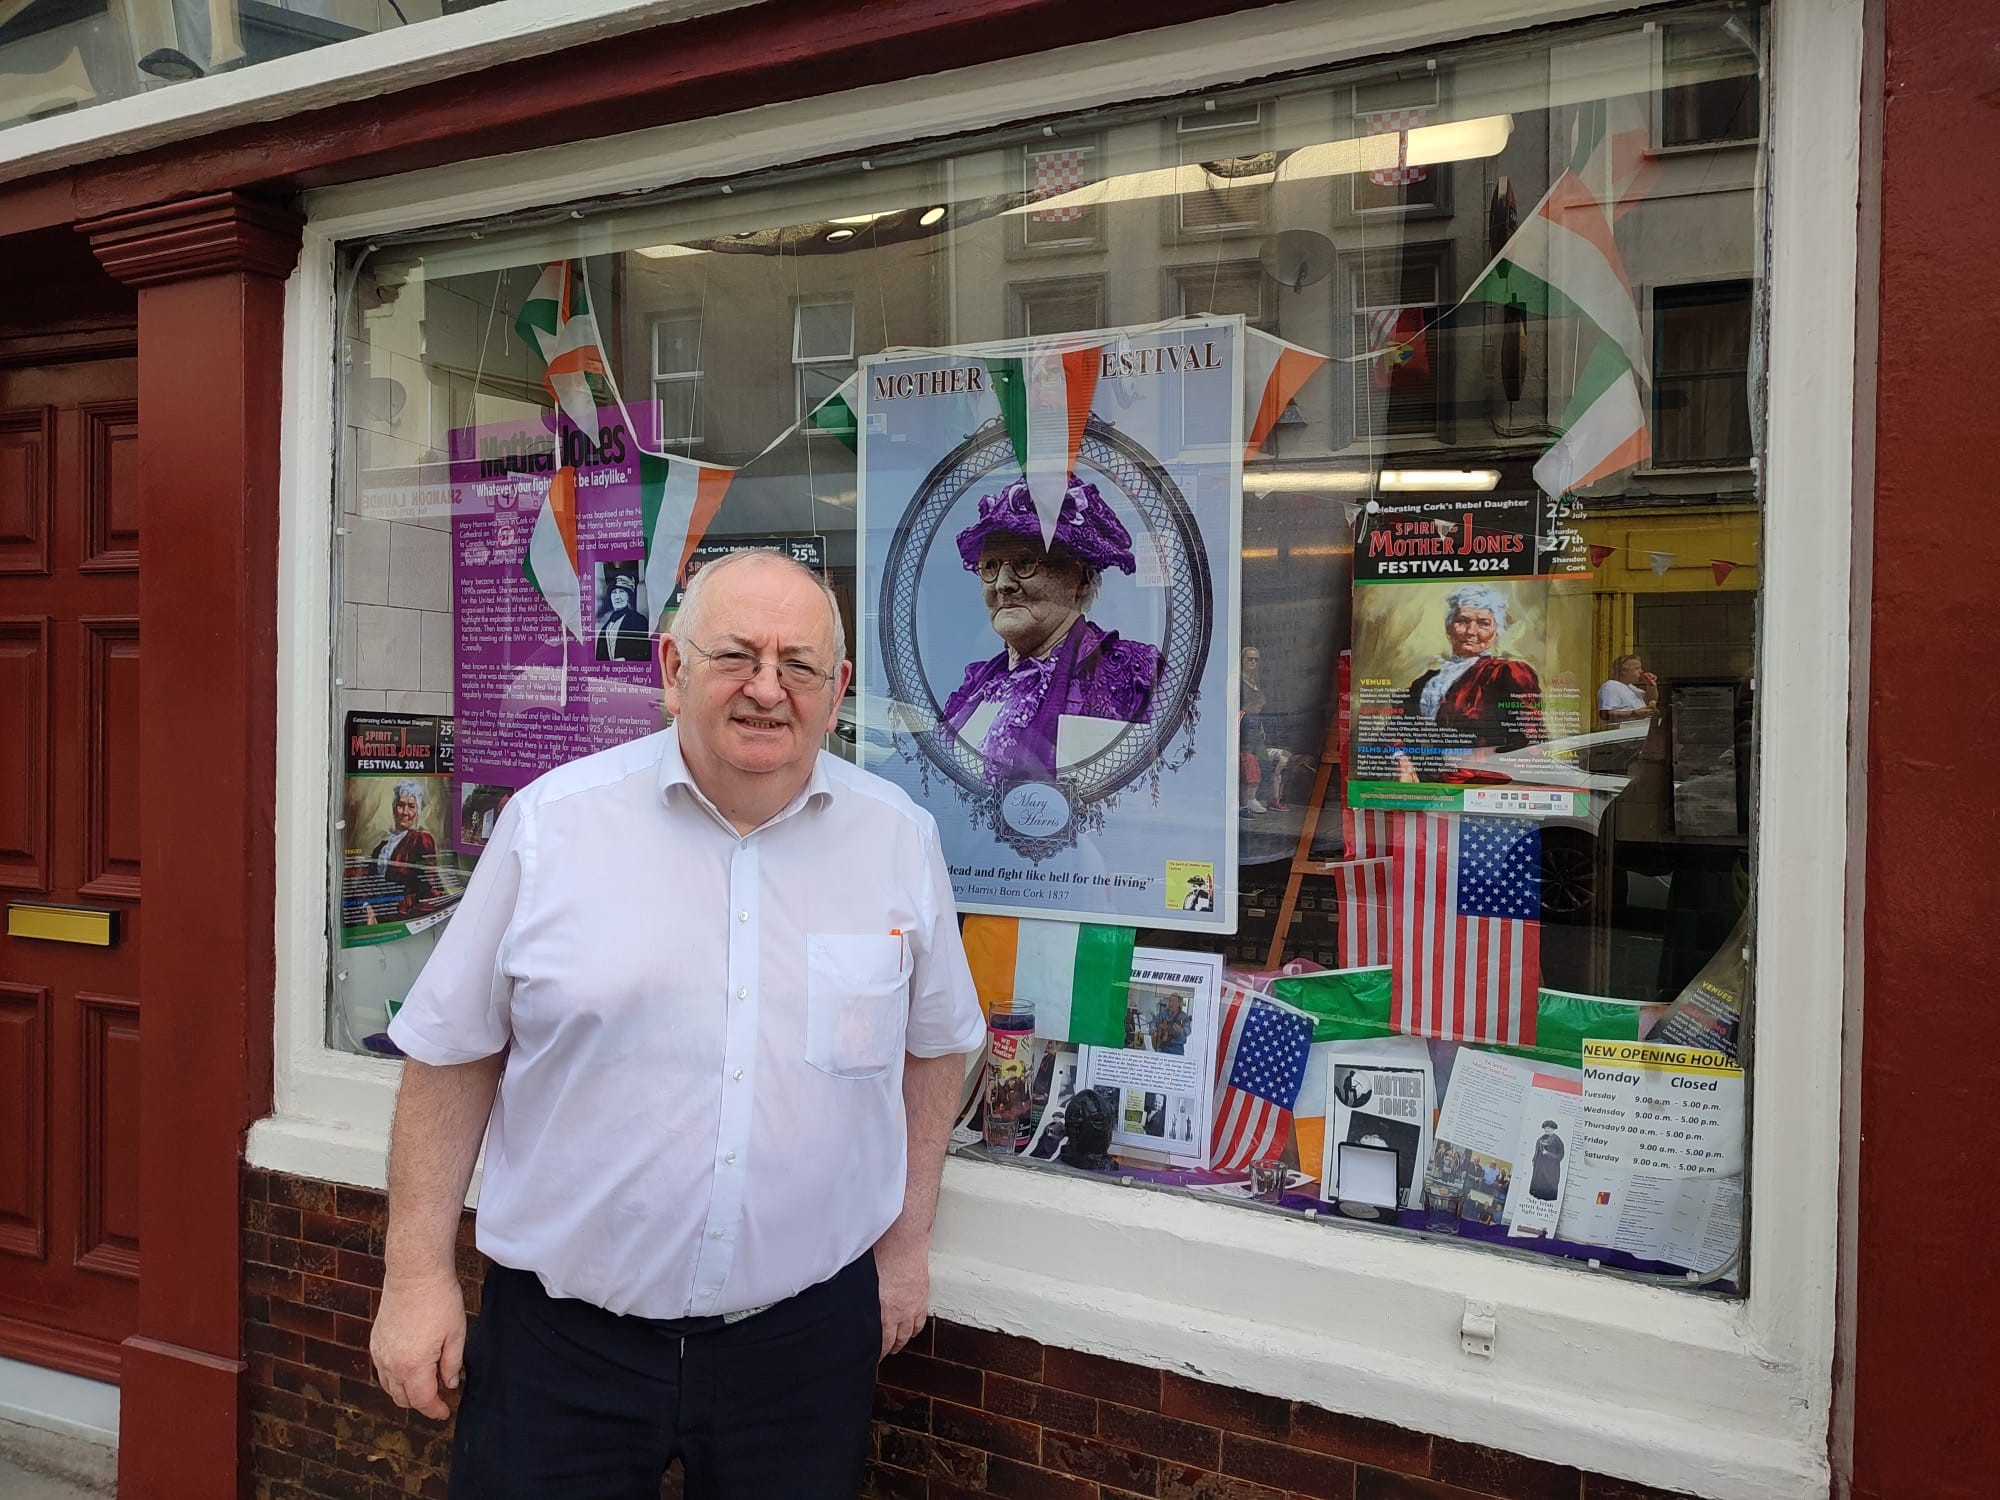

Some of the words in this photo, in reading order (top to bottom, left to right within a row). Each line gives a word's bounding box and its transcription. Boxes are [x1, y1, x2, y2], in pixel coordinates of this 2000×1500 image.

[874, 366, 984, 401] MOTHER
[1101, 342, 1223, 379] ESTIVAL
[560, 425, 626, 469] Jones
[471, 482, 513, 497] "Whatever
[514, 481, 531, 496] your
[579, 473, 589, 487] be
[591, 467, 632, 488] ladylike."
[1378, 504, 1421, 515] elebrating
[1423, 501, 1452, 511] Cork's
[1455, 501, 1481, 510] Rebel
[1483, 499, 1528, 510] Daughter
[605, 518, 620, 528] family
[1395, 519, 1444, 536] SPIRIT
[1368, 530, 1454, 557] MOTHER
[1457, 513, 1524, 556] JONES
[611, 542, 627, 551] young
[708, 545, 730, 553] Cork's
[792, 548, 817, 561] 25th
[1571, 545, 1587, 553] July
[809, 556, 820, 564] July
[1378, 560, 1464, 574] FESTIVAL
[1469, 558, 1510, 571] 2024
[512, 595, 532, 603] Workers
[612, 665, 644, 674] exploitation
[609, 685, 626, 693] where
[628, 685, 638, 693] she
[1360, 678, 1392, 686] VENUES
[353, 717, 380, 726] Celebrating
[554, 723, 578, 732] published
[617, 717, 652, 726] reverberates
[351, 735, 397, 757] MOTHER
[398, 727, 431, 758] JONES
[365, 731, 392, 741] SPIRIT
[358, 759, 403, 770] FESTIVAL
[405, 760, 424, 770] 2024
[1010, 790, 1048, 815] Mary
[1018, 810, 1060, 828] Harris
[947, 865, 971, 877] dead
[974, 866, 995, 878] and
[997, 867, 1023, 881] fight
[1026, 869, 1046, 882] like
[1049, 870, 1069, 883] hell
[1072, 872, 1090, 884] for
[1092, 873, 1111, 886] the
[967, 883, 997, 896] Harris)
[999, 886, 1021, 897] Born
[1023, 887, 1044, 898] Cork
[1048, 889, 1069, 900] 1837
[1142, 970, 1151, 978] OF
[1152, 971, 1182, 981] MOTHER
[1182, 974, 1204, 984] JONES
[1702, 981, 1734, 1002] VENUES
[1584, 1044, 1617, 1058] NEW
[1620, 1047, 1687, 1065] OPENING
[1373, 1074, 1421, 1098] MOTHER
[1583, 1068, 1640, 1087] Monday
[1670, 1076, 1718, 1091] Closed
[1378, 1097, 1417, 1118] JONES
[1584, 1090, 1616, 1101] Tuesday
[1634, 1096, 1652, 1104] 9.00
[1682, 1100, 1700, 1109] 5.00
[1702, 1103, 1721, 1112] p.m.
[1583, 1106, 1625, 1118] Wednsday
[1634, 1111, 1652, 1120] 9.00
[1680, 1116, 1699, 1124] 5.00
[1700, 1118, 1719, 1127] p.m.
[1583, 1120, 1620, 1133] Thursday
[1620, 1125, 1637, 1134] 9.00
[1665, 1130, 1684, 1139] 5.00
[1685, 1133, 1704, 1142] p.m.
[1584, 1135, 1608, 1146] Friday
[1639, 1143, 1657, 1152] 9.00
[1685, 1148, 1703, 1157] 5.00
[1705, 1151, 1724, 1160] p.m.
[1584, 1150, 1620, 1163] Saturday
[1632, 1157, 1650, 1166] 9.00
[1679, 1163, 1697, 1172] 5.00
[1698, 1165, 1717, 1174] p.m.
